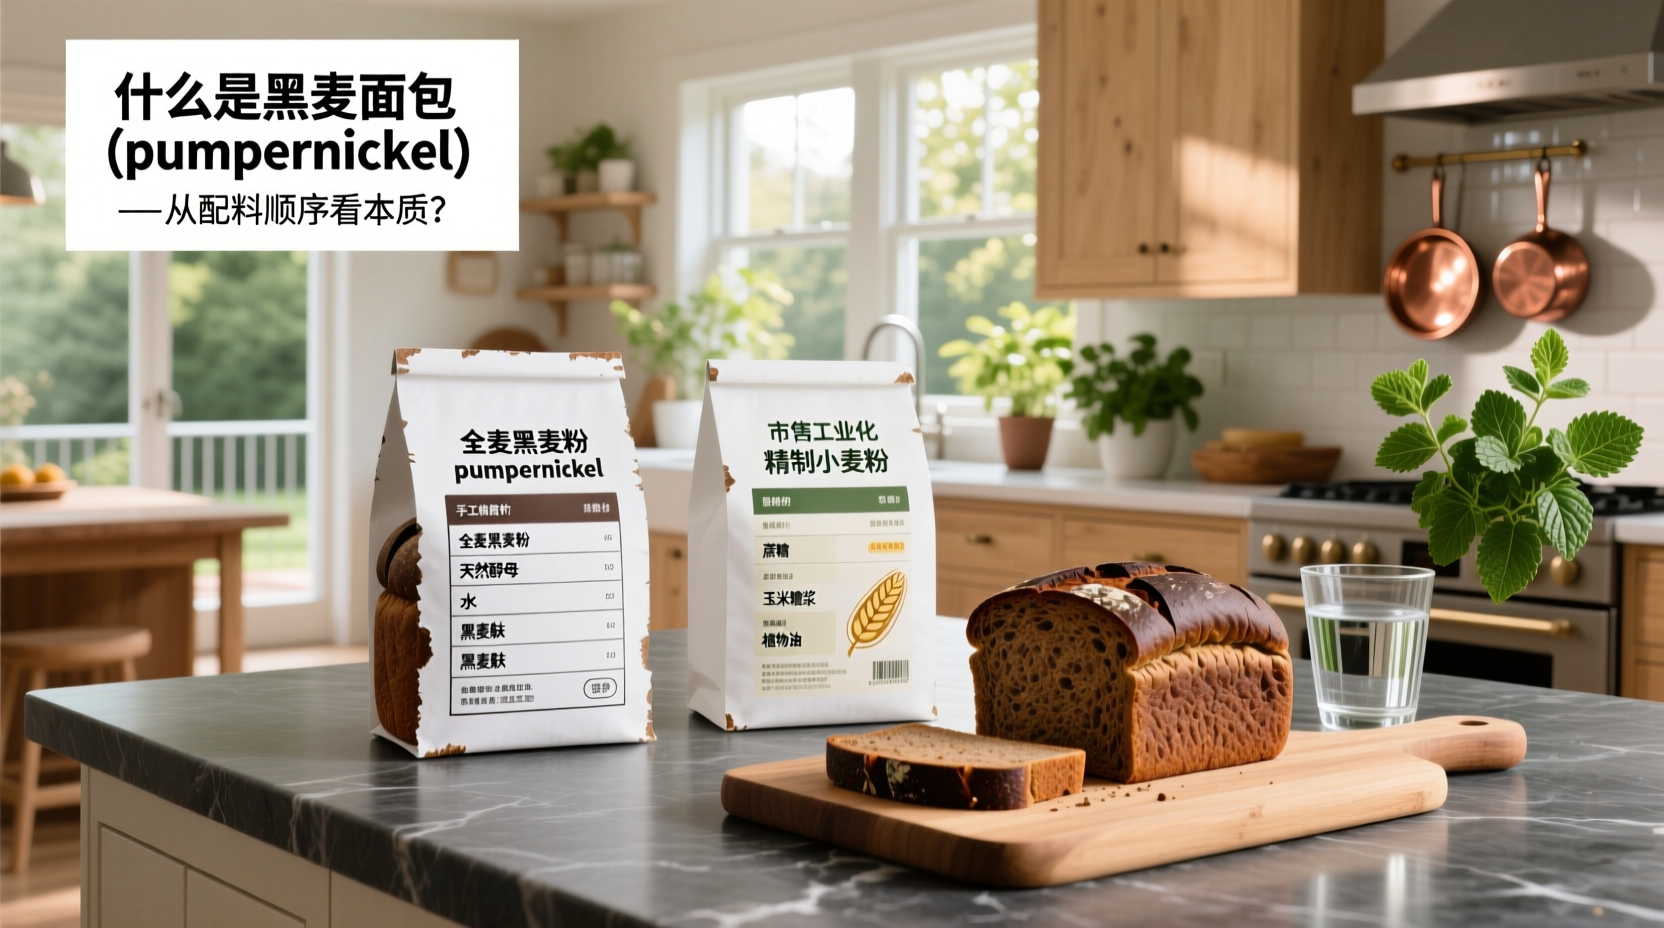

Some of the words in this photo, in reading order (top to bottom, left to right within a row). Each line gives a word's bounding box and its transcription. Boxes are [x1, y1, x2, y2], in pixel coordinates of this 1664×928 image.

[460, 428, 588, 455] 全麦黑麦粉
[767, 420, 879, 443] 市售工业化
[454, 457, 604, 484] pumpernickel
[763, 447, 889, 475] 精制小麦粉
[460, 592, 477, 610] 水
